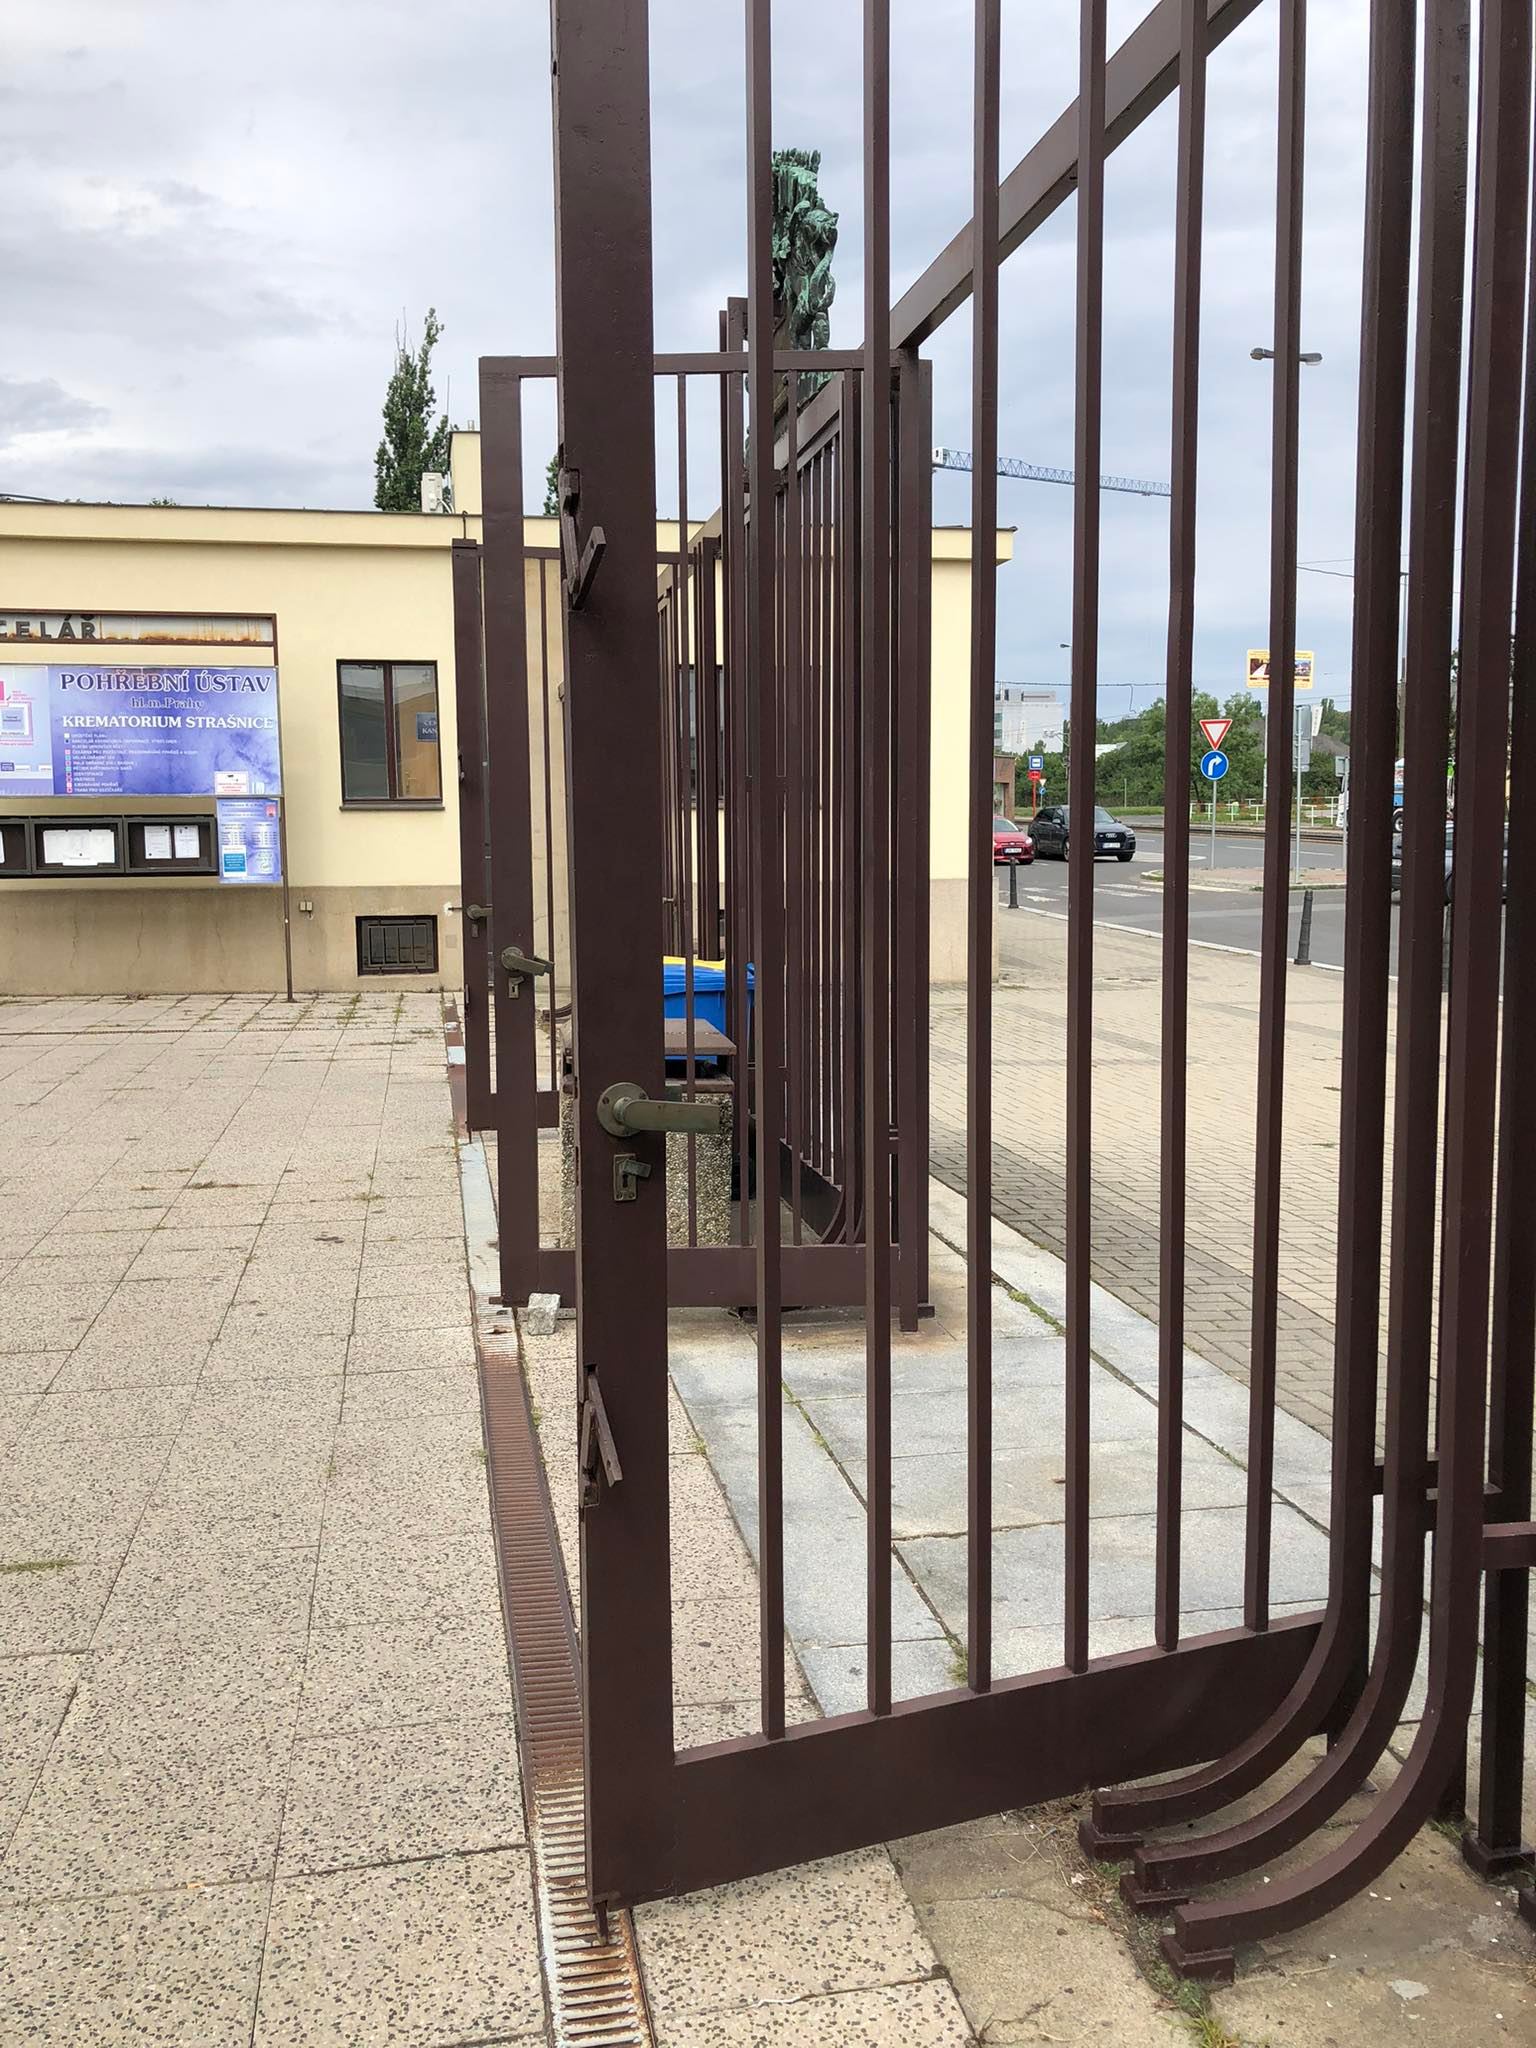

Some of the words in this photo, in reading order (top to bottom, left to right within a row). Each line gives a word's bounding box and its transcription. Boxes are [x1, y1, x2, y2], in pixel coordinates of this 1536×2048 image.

[60, 670, 189, 692] POHŘEBNÍ
[196, 670, 271, 694] ÚSTAV
[62, 715, 182, 729] KREMATORIUM
[185, 714, 274, 730] STRAŠNICE
